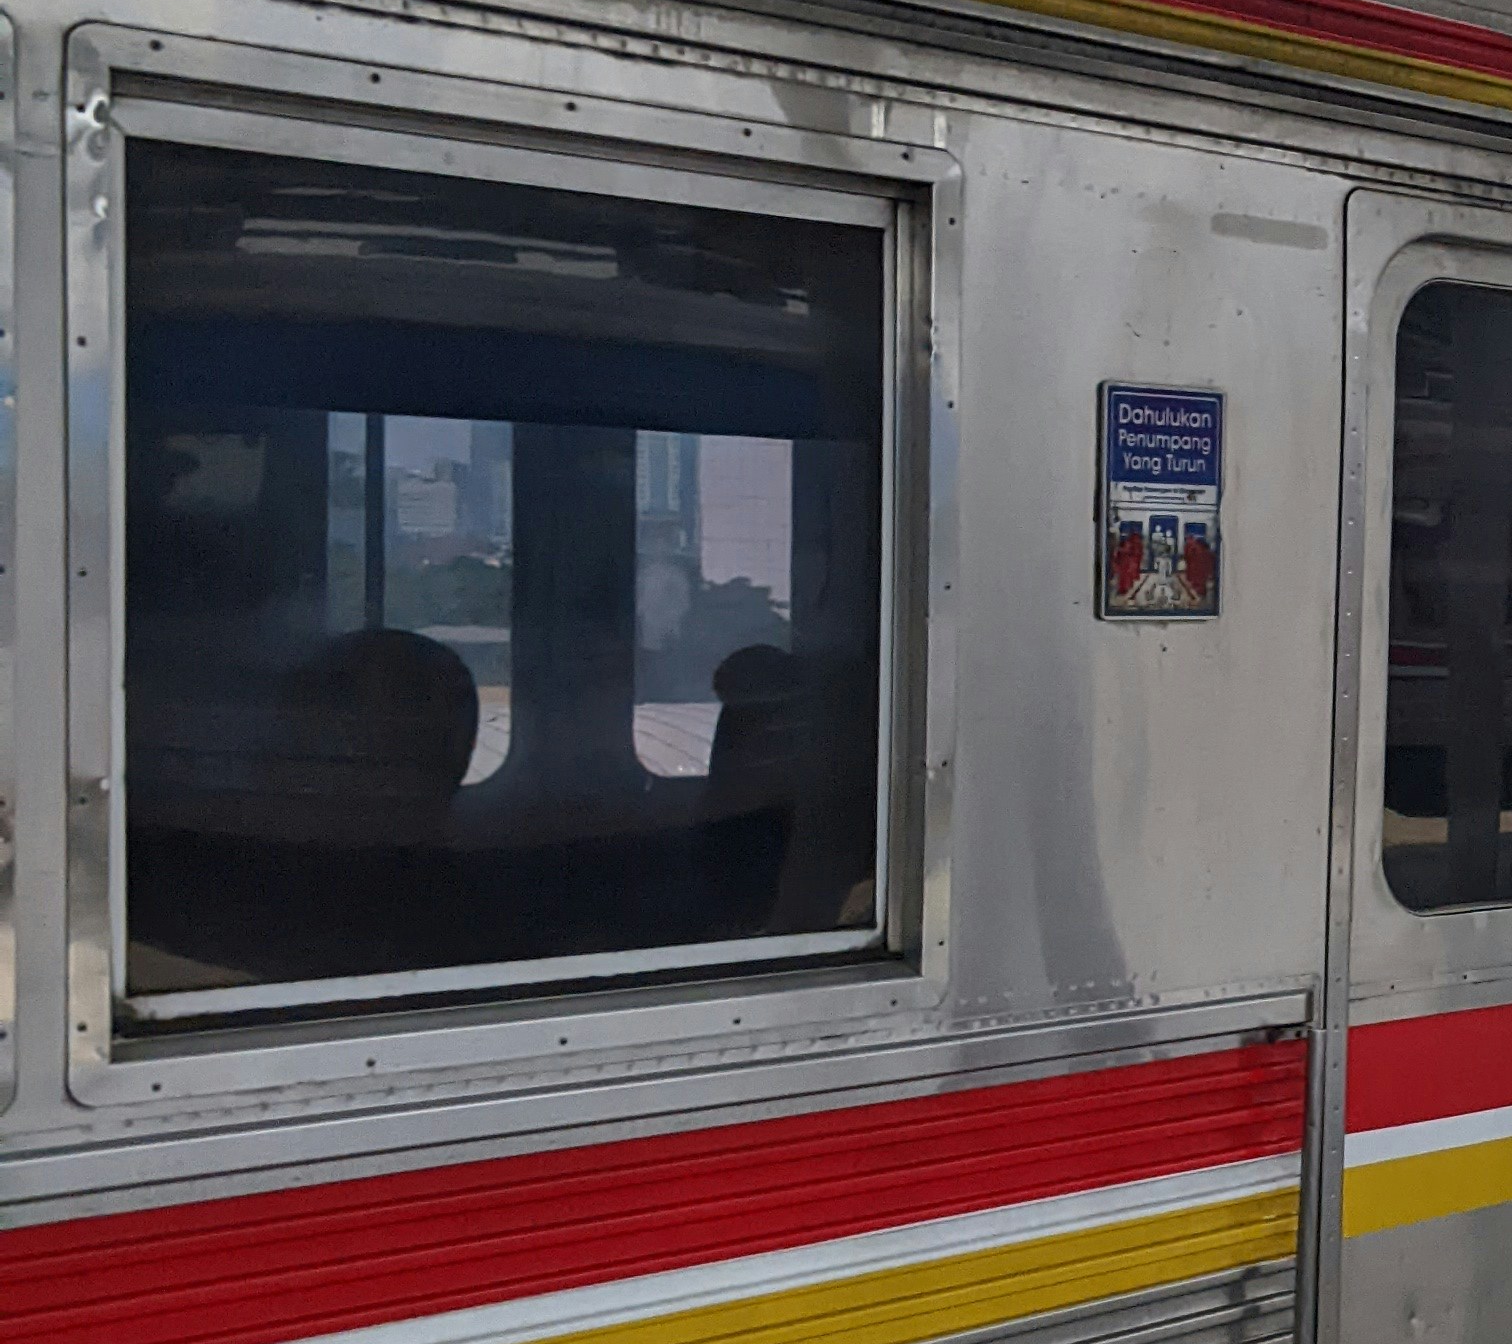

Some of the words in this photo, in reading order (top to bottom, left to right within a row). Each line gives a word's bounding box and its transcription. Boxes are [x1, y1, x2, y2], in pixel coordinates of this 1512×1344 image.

[1119, 403, 1212, 428] Dahulukan
[1118, 429, 1211, 455] Penumpang
[1123, 452, 1162, 476] Yang
[1166, 454, 1206, 472] Turun
